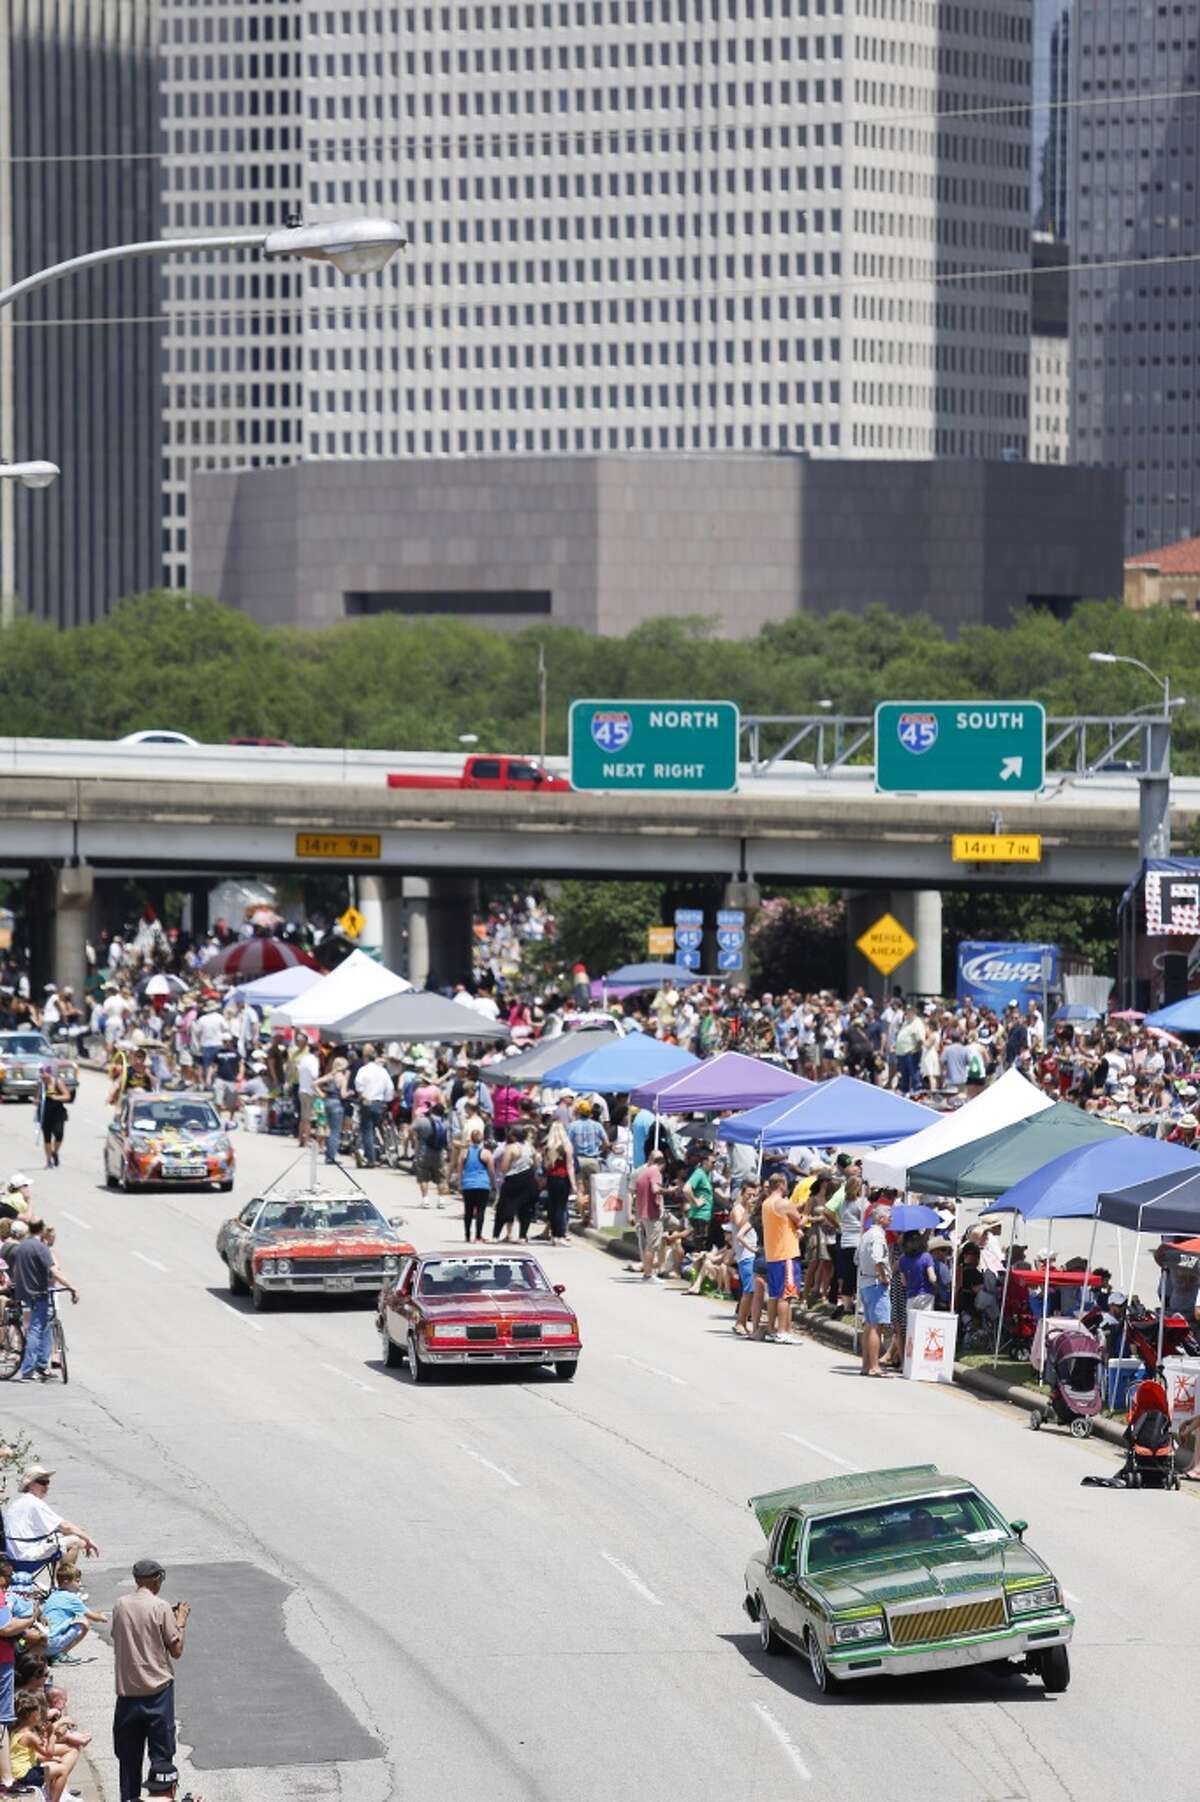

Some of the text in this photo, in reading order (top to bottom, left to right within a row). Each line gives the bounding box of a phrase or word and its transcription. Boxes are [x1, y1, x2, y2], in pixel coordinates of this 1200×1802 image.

[650, 711, 719, 728] NORTH
[956, 712, 1024, 729] SOUTH
[596, 722, 629, 744] 45
[902, 723, 935, 746] 45
[603, 763, 704, 778] NEXT RIGHT
[679, 931, 699, 945] 45
[721, 933, 741, 947] 45
